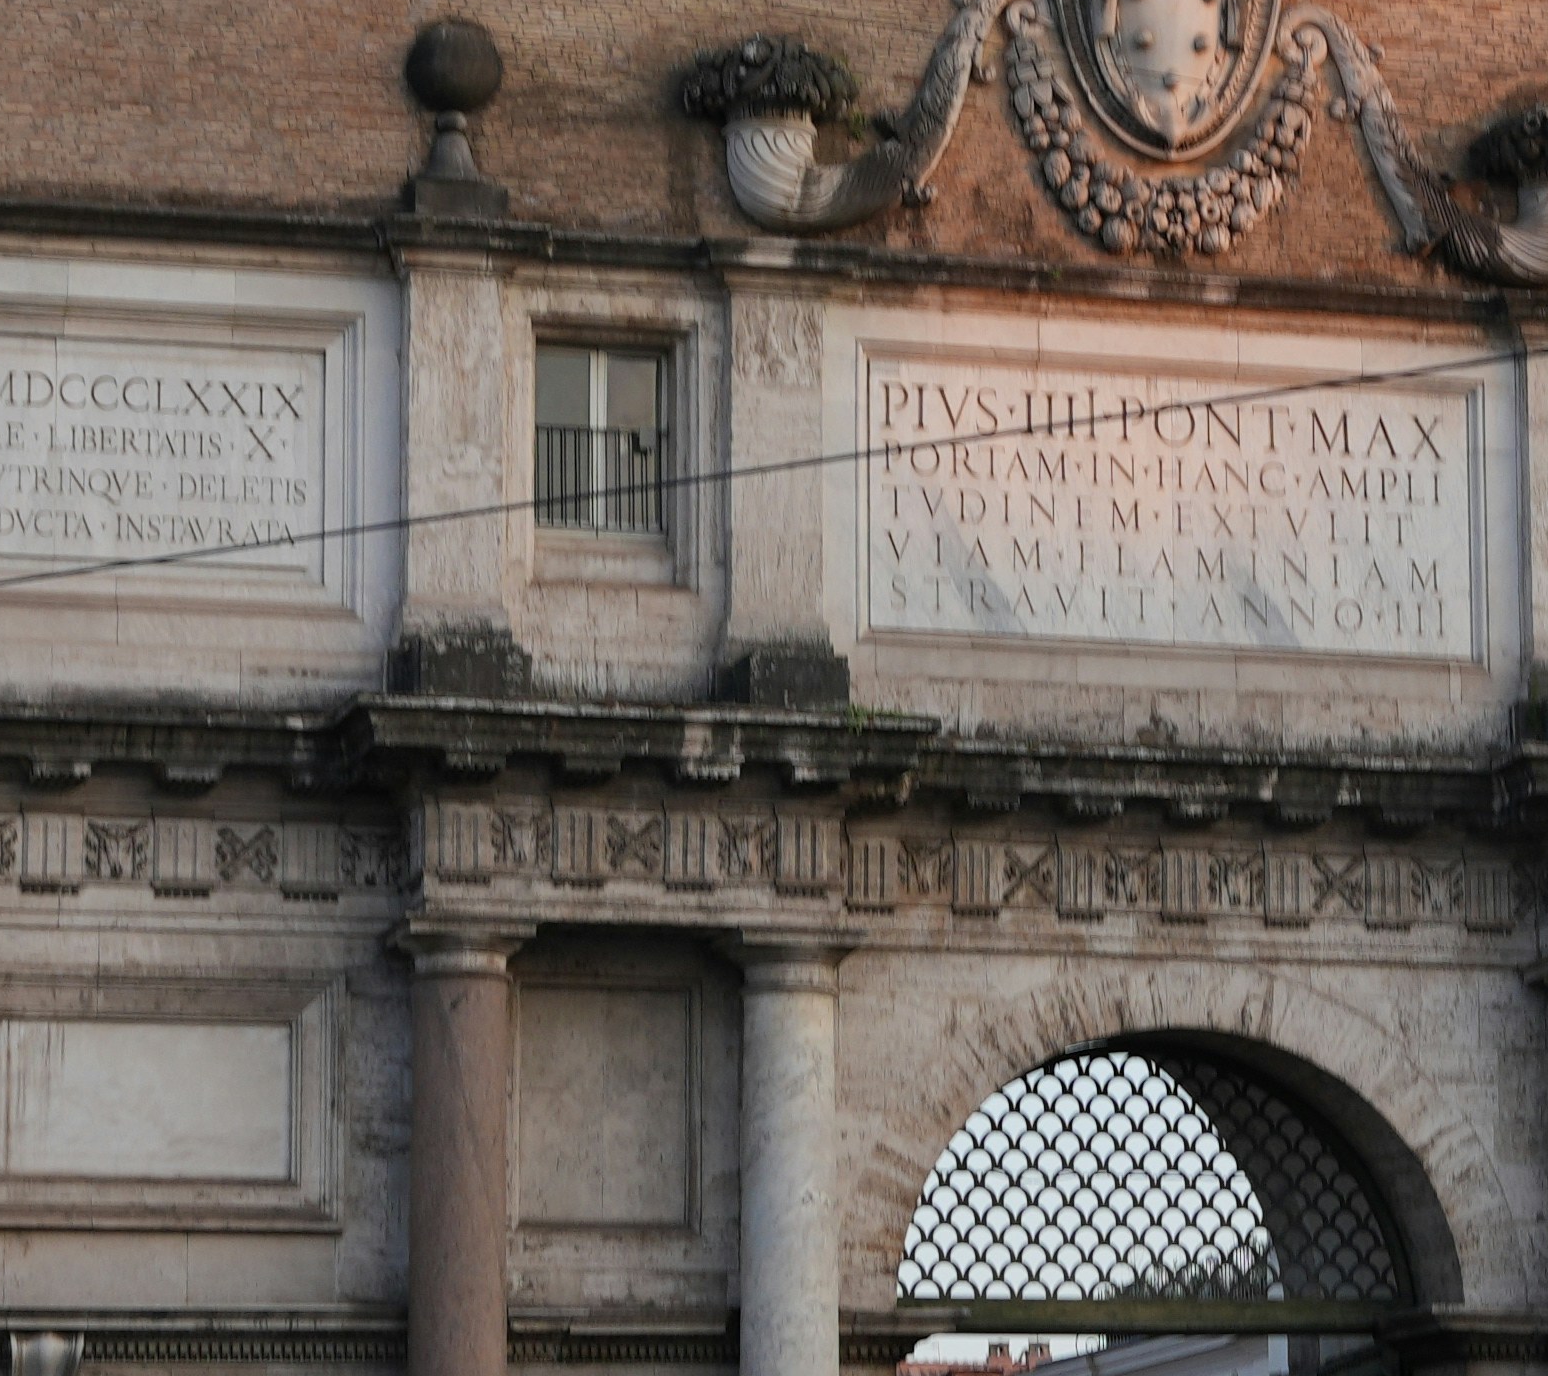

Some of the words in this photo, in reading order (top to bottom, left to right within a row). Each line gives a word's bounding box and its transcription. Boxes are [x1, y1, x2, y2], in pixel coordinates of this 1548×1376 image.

[49, 422, 223, 458] LIBERTATIS
[244, 425, 277, 463] X
[881, 381, 999, 438] PIVS
[1023, 385, 1098, 443] IIII
[1120, 399, 1289, 453] PONT
[1310, 409, 1445, 464] MAX
[176, 472, 308, 506] DELETIS
[882, 440, 1069, 486] PORTAM
[1090, 455, 1136, 490] IN
[1158, 456, 1288, 497] HANC
[1309, 464, 1442, 508] AMPLI
[116, 513, 298, 547] INSTAVRATA
[883, 485, 1144, 535] TVDINEM
[1176, 500, 1414, 548] EXTVLIT
[889, 530, 1044, 572] VIAM
[1078, 542, 1442, 594] FLAMINIAM
[890, 574, 1156, 624] STRAVIT
[1203, 589, 1364, 631] ANNO
[1394, 599, 1446, 639] III
